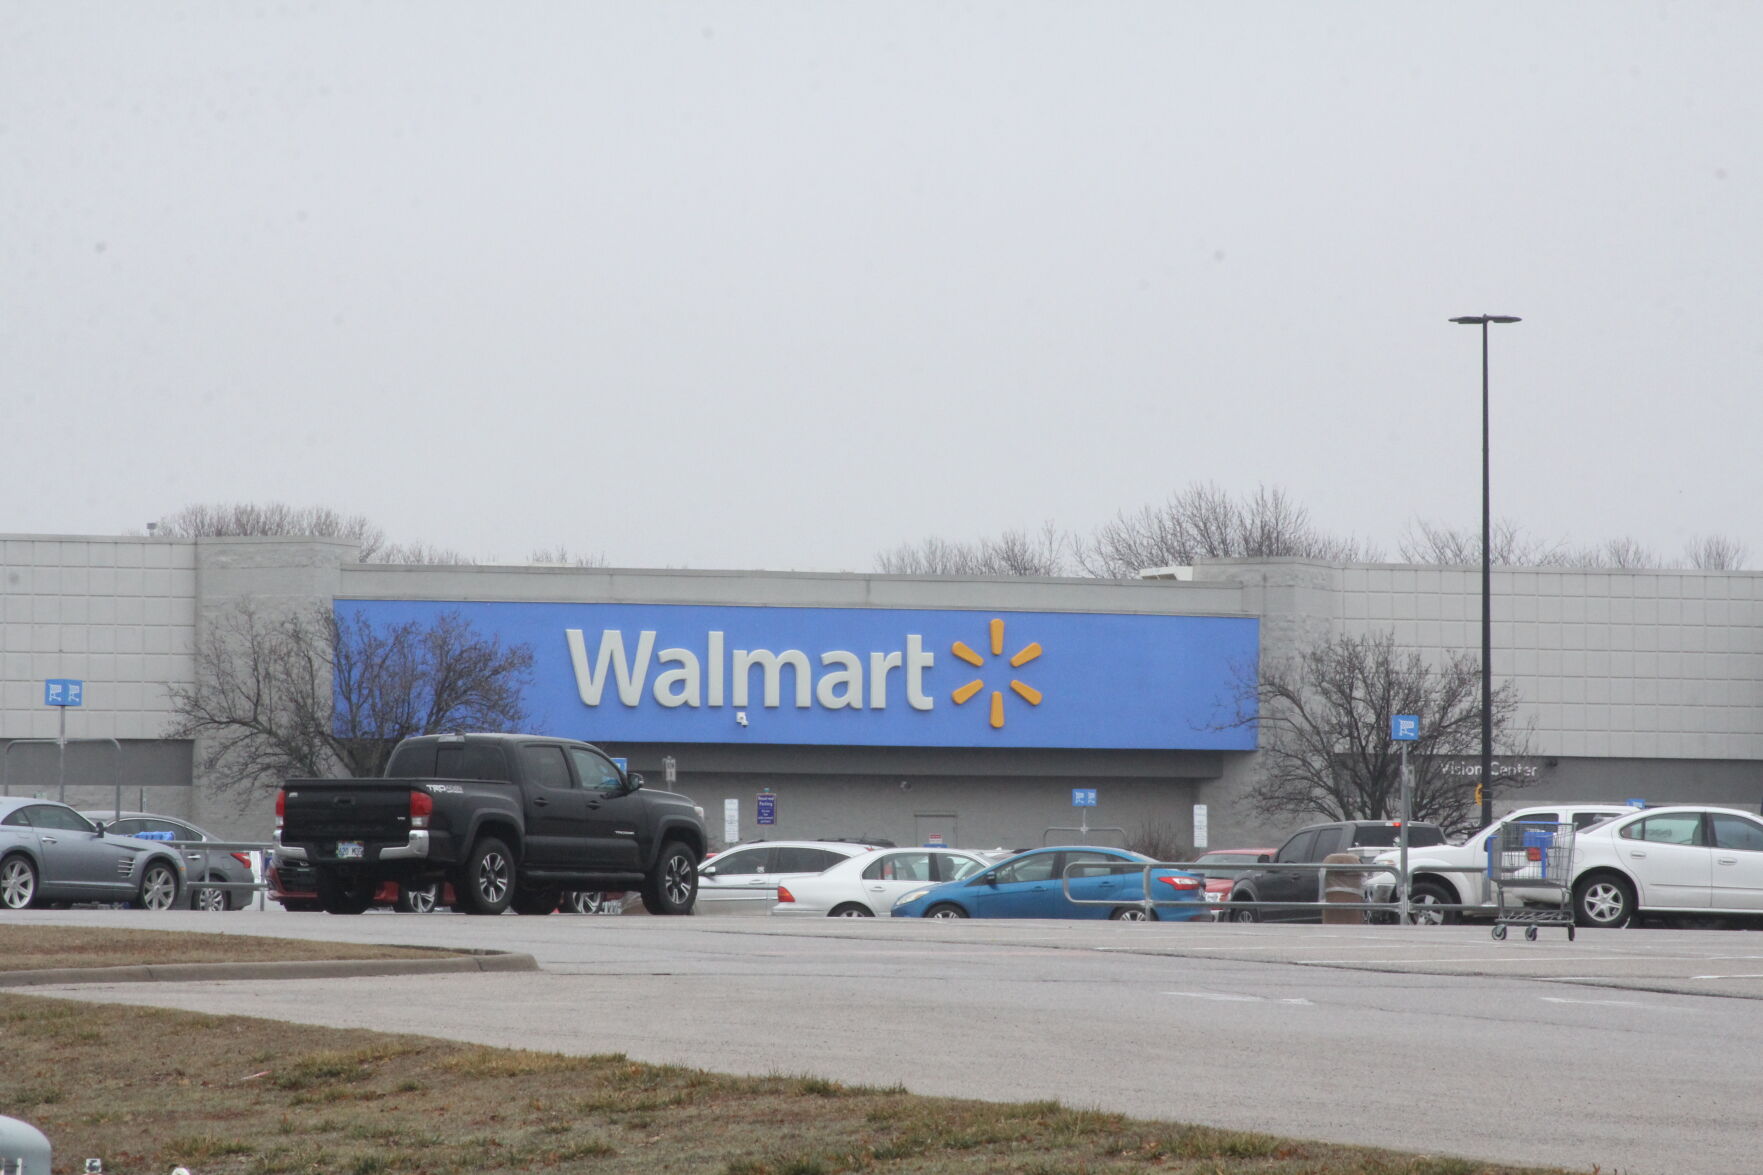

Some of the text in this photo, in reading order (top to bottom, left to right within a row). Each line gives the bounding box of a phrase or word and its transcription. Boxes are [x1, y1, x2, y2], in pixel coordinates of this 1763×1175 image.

[565, 628, 935, 711] Walmart
[1440, 761, 1537, 777] Vision Center
